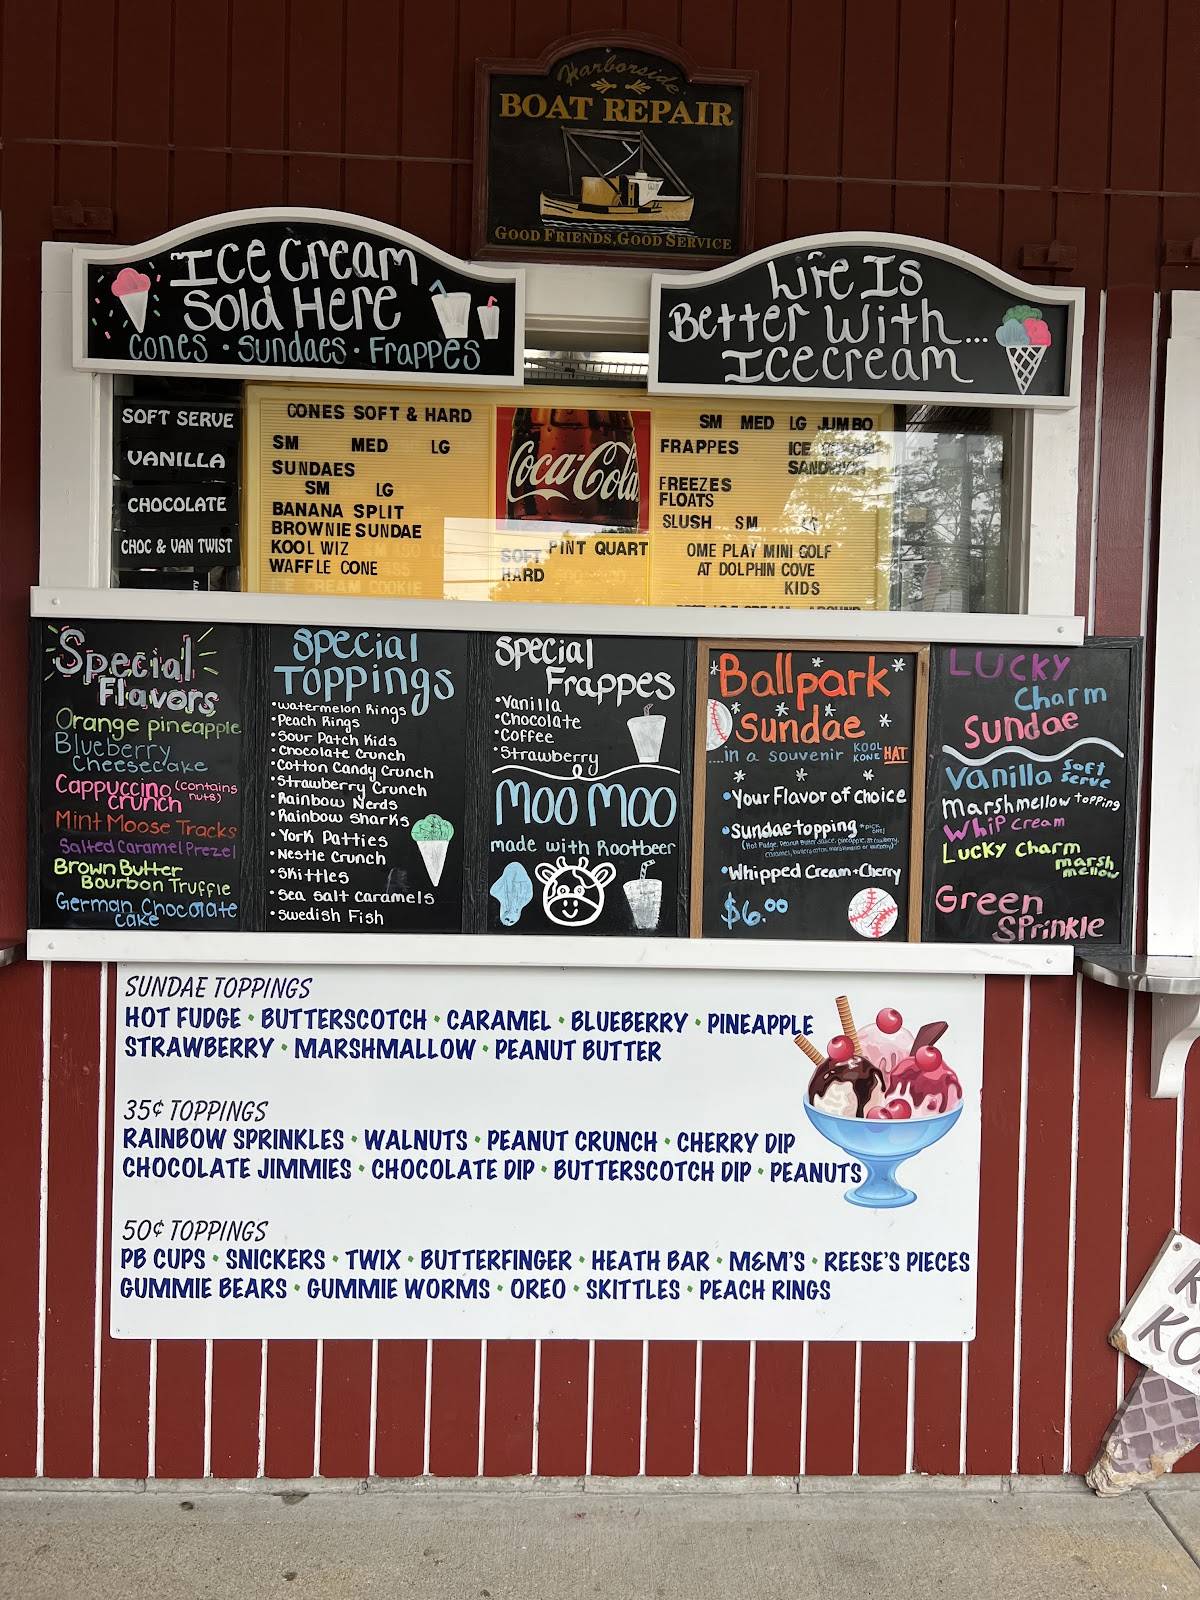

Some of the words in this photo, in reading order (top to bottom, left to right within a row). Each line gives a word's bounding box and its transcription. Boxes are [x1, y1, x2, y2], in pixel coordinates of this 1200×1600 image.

[556, 54, 681, 96] Harborside
[499, 93, 593, 120] BOAT
[602, 98, 736, 126] REPAIR
[495, 226, 541, 241] GOOD
[666, 234, 732, 250] SERVICE
[169, 239, 272, 287] Ice
[279, 237, 418, 285] Cream
[861, 255, 923, 299] Is
[183, 285, 284, 332] Sold
[295, 285, 401, 330] Here
[667, 302, 810, 343] Better
[238, 334, 346, 365] Sundaes
[369, 336, 480, 369] Frappes
[122, 408, 170, 426] SOFT
[177, 411, 234, 428] SERVE
[288, 403, 344, 419] CONES
[353, 405, 399, 421] SOFT
[406, 407, 418, 421] &
[425, 408, 472, 423] HARD
[700, 415, 722, 429] SM
[741, 416, 775, 430] MED
[790, 416, 807, 431] LG
[817, 416, 873, 431] JUMBO
[272, 435, 299, 450] SM
[351, 438, 388, 452] MED
[431, 440, 450, 454] LG
[660, 438, 739, 455] FRAPPES
[788, 441, 810, 456] ICE
[127, 451, 226, 469] VANILLA
[272, 460, 355, 477] SUNDAES
[507, 440, 639, 503] Coca-Cola
[305, 481, 330, 496] SM
[376, 482, 394, 498] LG
[660, 476, 732, 492] FREEZES
[128, 497, 227, 512] CHOCOLATE
[659, 493, 714, 508] FLOATS
[272, 502, 343, 518] BANANA
[353, 504, 404, 519] SPLIT
[272, 521, 351, 537] BROWNIE
[355, 522, 422, 539] SUNDAE
[662, 514, 712, 530] SLUSH
[735, 516, 758, 530] SM
[121, 539, 151, 554] CHOC
[156, 540, 166, 554] &
[171, 539, 193, 554] VAN
[198, 538, 232, 554] TWIST
[271, 539, 315, 555] KOOL
[321, 541, 349, 556] WIZ
[549, 540, 586, 554] PINT
[595, 541, 648, 555] QUART
[723, 544, 756, 558] PLAY
[763, 544, 792, 558] MINI
[800, 544, 832, 559] GOLF
[269, 558, 331, 575] WAFFLE
[340, 561, 378, 576] CONE
[502, 568, 544, 582] HARD
[697, 562, 712, 576] AT
[719, 562, 775, 576] DOLPHIN
[782, 563, 815, 577] COVE
[784, 581, 820, 595] KIDS
[55, 628, 192, 684] Special
[546, 666, 676, 707] Frappes
[720, 652, 891, 711] Ballpark
[100, 678, 219, 715] Flavors
[501, 694, 562, 712] Vanilla
[1014, 686, 1107, 711] Charm
[366, 704, 407, 724] Rings
[501, 711, 582, 730] Chocolate
[56, 707, 140, 741] Orange
[278, 715, 316, 727] Peach
[322, 716, 360, 733] Rings
[736, 704, 866, 744] Sundae
[278, 730, 312, 743] Sour
[318, 732, 359, 746] Patch
[364, 734, 397, 747] Kids
[500, 728, 554, 744] Coffee
[55, 732, 171, 766] Blueberry
[279, 745, 350, 759] Chocolate
[356, 748, 405, 762] Crunch
[746, 751, 759, 761] a
[768, 748, 844, 763] souvenir
[854, 742, 882, 752] KOOL
[884, 746, 909, 761] HAT
[854, 753, 881, 762] KONE
[73, 755, 208, 773] Cheesecake
[500, 745, 599, 776] Strawberry
[277, 759, 328, 773] Cotton
[333, 762, 376, 782] Candy
[381, 765, 434, 779] Crunch
[55, 774, 171, 801] Cappuccino
[175, 780, 238, 794] (contains
[277, 775, 365, 801] Strawberry
[372, 781, 427, 797] Crunch
[108, 795, 183, 813] crunch
[278, 792, 345, 808] Rainbow
[353, 798, 398, 810] Nerds
[732, 789, 770, 809] Your
[774, 786, 827, 805] Flavor
[831, 787, 851, 803] of
[55, 810, 103, 831] Mint
[107, 814, 171, 834] Moose
[176, 819, 238, 839] Tracks
[278, 809, 343, 824] Rainbow
[279, 829, 314, 843] York
[323, 830, 388, 848] Patties
[731, 821, 793, 840] Sundae
[59, 838, 114, 854] Salted
[118, 840, 183, 855] Caramel
[186, 842, 236, 859] Prezel
[277, 848, 325, 862] Nestle
[490, 835, 537, 852] made
[546, 839, 589, 855] with
[597, 840, 676, 857] Rootbeer
[54, 858, 116, 875] Brown
[119, 859, 183, 877] Butter
[278, 867, 350, 884] Skittles
[728, 863, 800, 885] Whipped
[81, 875, 163, 892] Bourbon
[278, 888, 306, 901] Sea
[935, 885, 1044, 916] Green
[56, 892, 132, 913] German
[141, 898, 238, 918] Chocolate
[349, 909, 384, 925] Fish
[233, 1129, 344, 1150] SPRINKLES
[364, 1130, 468, 1151] WALNUTS
[487, 1130, 569, 1152] PEANUT
[574, 1131, 658, 1153] CRUNCH
[677, 1132, 758, 1153] CHERRY
[257, 1158, 352, 1180] JIMMIES
[371, 1158, 501, 1181] CHOCOLATE
[553, 1160, 715, 1182] BUTTERSCOTCH
[721, 1161, 752, 1183] DIP
[770, 1162, 862, 1183] PEANUTS
[153, 1249, 206, 1270] CUPS
[226, 1249, 326, 1270] SNICKERS
[346, 1249, 401, 1270] TWIX
[420, 1249, 572, 1271] BUTTERFINGER
[592, 1250, 661, 1271] HEATH
[667, 1251, 711, 1272] BAR
[906, 1251, 970, 1272] PIECES
[219, 1278, 287, 1299] BEARS
[307, 1278, 398, 1300] GUMMIE
[404, 1278, 490, 1300] WORMS
[510, 1279, 566, 1300] OREO
[586, 1279, 681, 1300] SKITTLES
[700, 1279, 765, 1300] PEACH
[772, 1279, 831, 1300] RINGS
